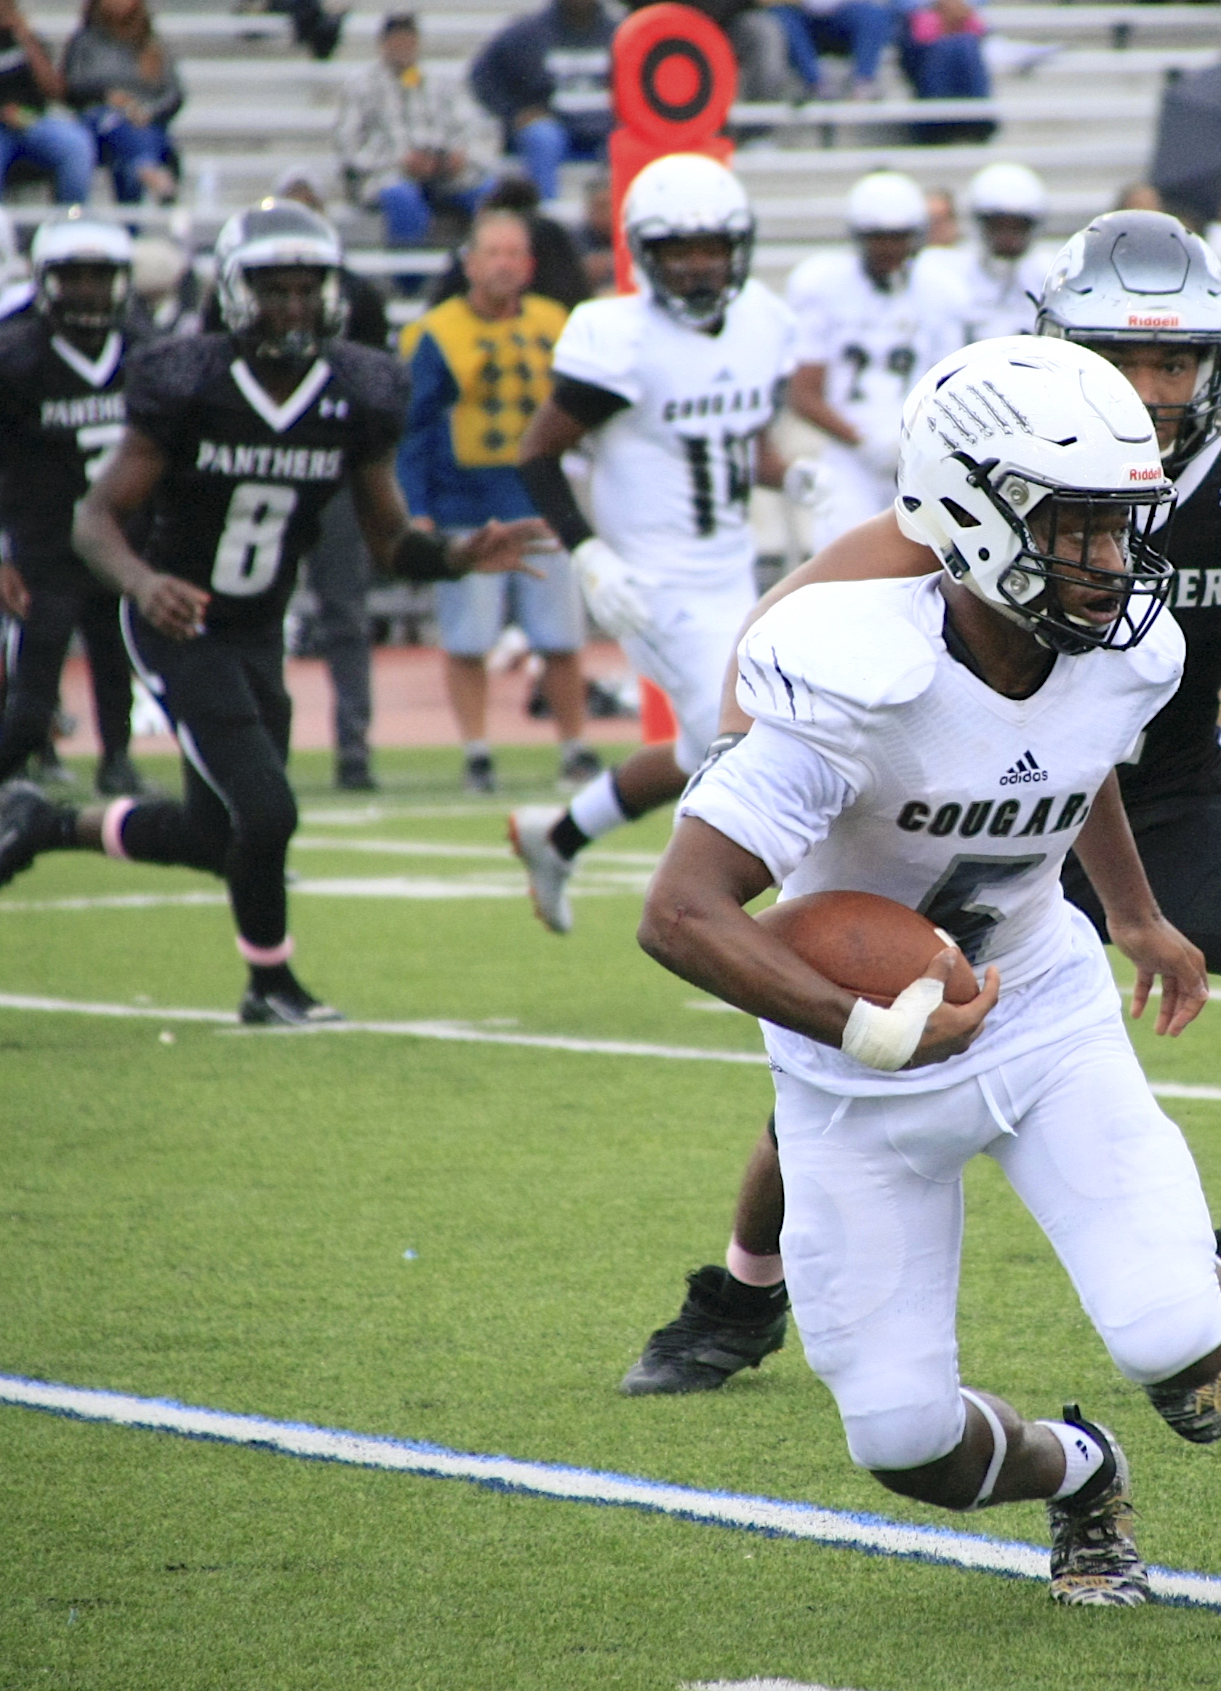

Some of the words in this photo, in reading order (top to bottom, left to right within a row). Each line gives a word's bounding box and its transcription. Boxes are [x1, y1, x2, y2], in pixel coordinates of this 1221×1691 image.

[1128, 314, 1179, 327] Riddell
[197, 439, 342, 479] PANTHERS
[210, 481, 298, 597] 8
[1000, 768, 1048, 786] adidas
